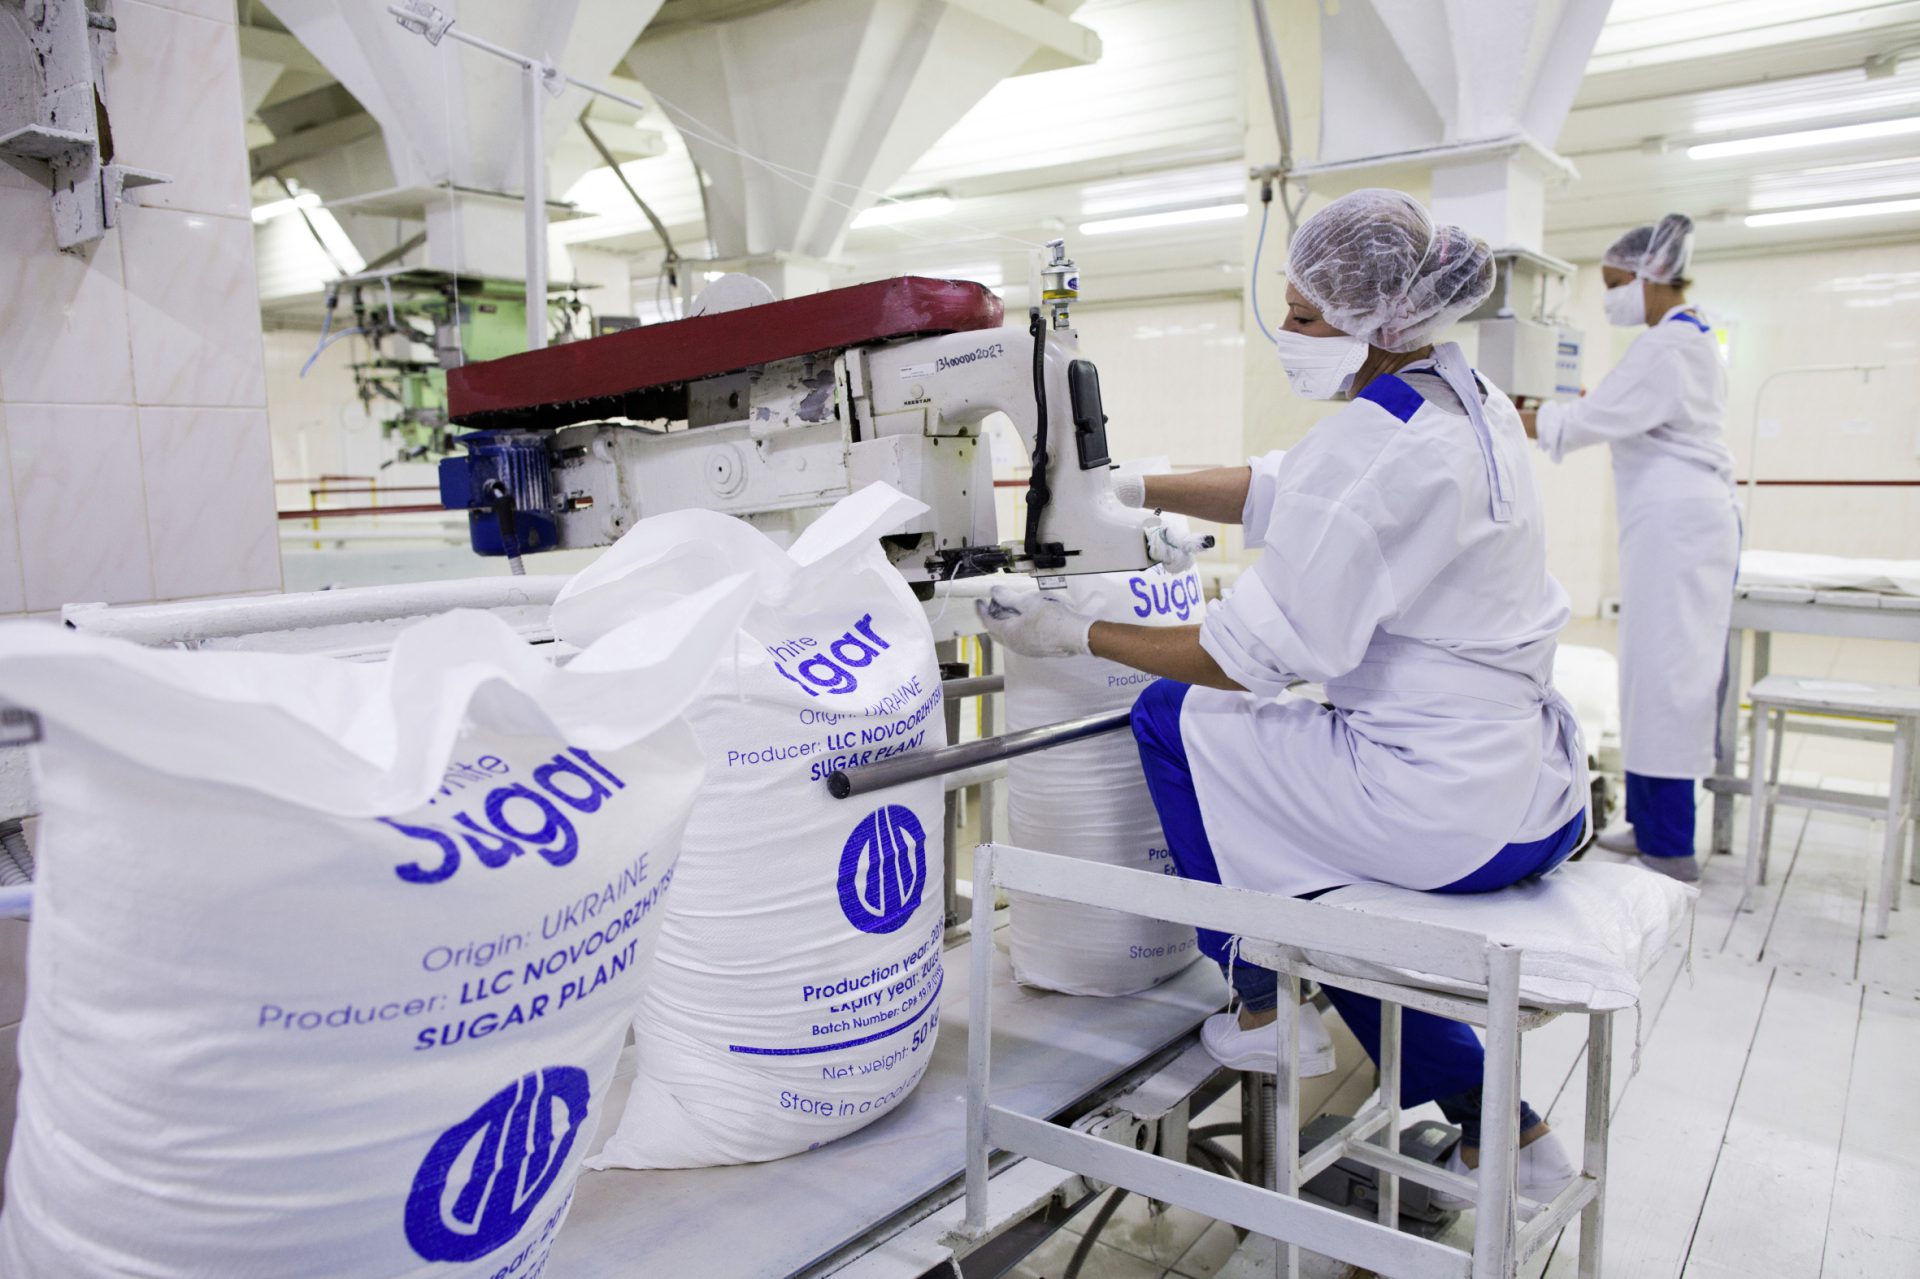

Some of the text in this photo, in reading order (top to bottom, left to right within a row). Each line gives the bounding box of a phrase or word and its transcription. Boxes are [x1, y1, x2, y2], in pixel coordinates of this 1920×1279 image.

[1128, 574, 1200, 621] Suga
[766, 636, 818, 662] hite
[728, 684, 943, 767] Producer: LLC NOVOORZHYTSK
[810, 729, 926, 782] SUGAR PLANT
[422, 851, 649, 972] Origin: UKRAINE
[803, 963, 899, 1002] Production
[902, 940, 930, 973] year:
[1129, 945, 1165, 959] Store
[1166, 943, 1177, 955] in
[258, 994, 449, 1030] Producer:
[459, 970, 515, 1006] LLC
[413, 938, 640, 1052] SUGAR PLANT
[887, 973, 920, 1001] year:
[811, 1020, 850, 1036] Batch
[852, 1008, 900, 1029] Number:
[858, 1047, 909, 1075] weight:
[911, 1022, 928, 1052] 50
[780, 1091, 833, 1117] Store
[838, 1100, 855, 1117] in
[859, 1101, 872, 1114] a
